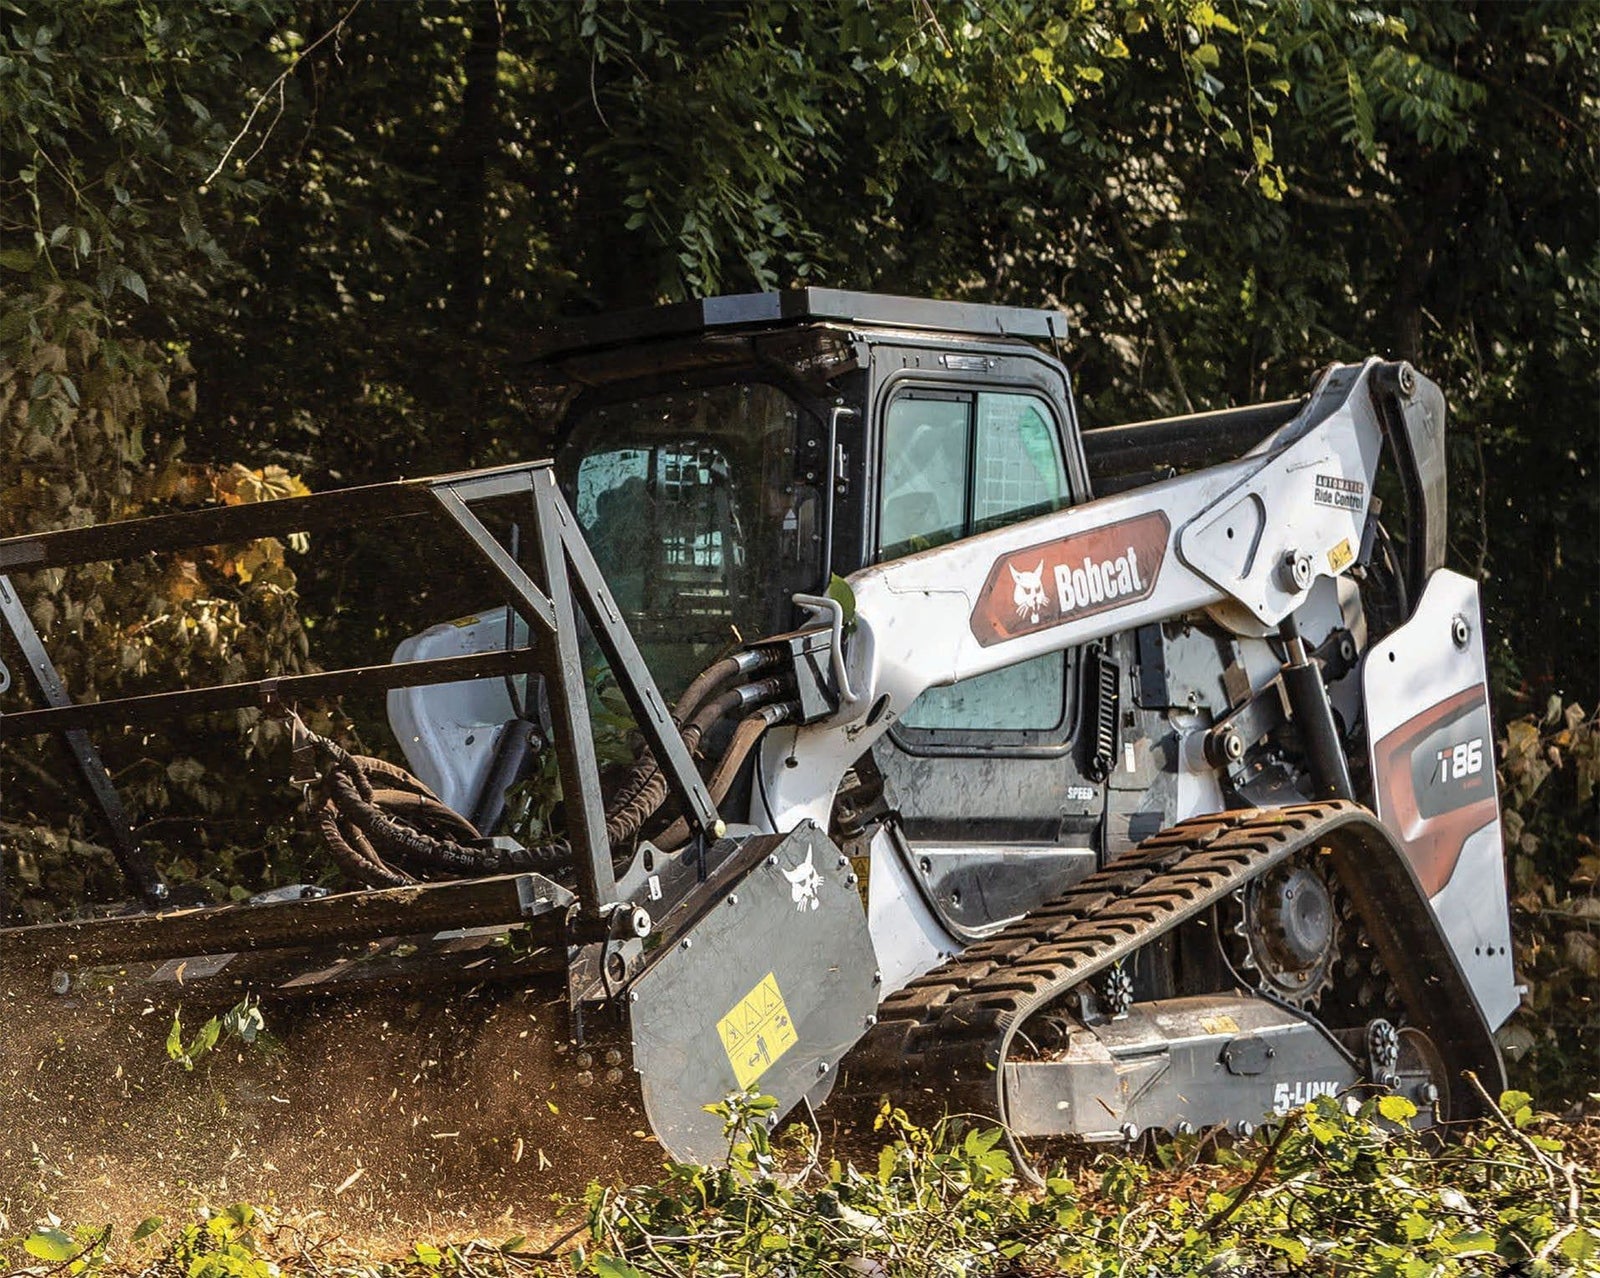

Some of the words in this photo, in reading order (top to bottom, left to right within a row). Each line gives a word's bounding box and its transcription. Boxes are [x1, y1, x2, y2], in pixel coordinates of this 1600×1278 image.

[1316, 476, 1364, 494] AUTOMATIC
[1314, 488, 1332, 503] Ride
[1334, 491, 1363, 510] Control
[1054, 546, 1142, 613] Bobcat
[1067, 786, 1094, 801] SPEED
[1273, 1081, 1340, 1117] 5-LINK
